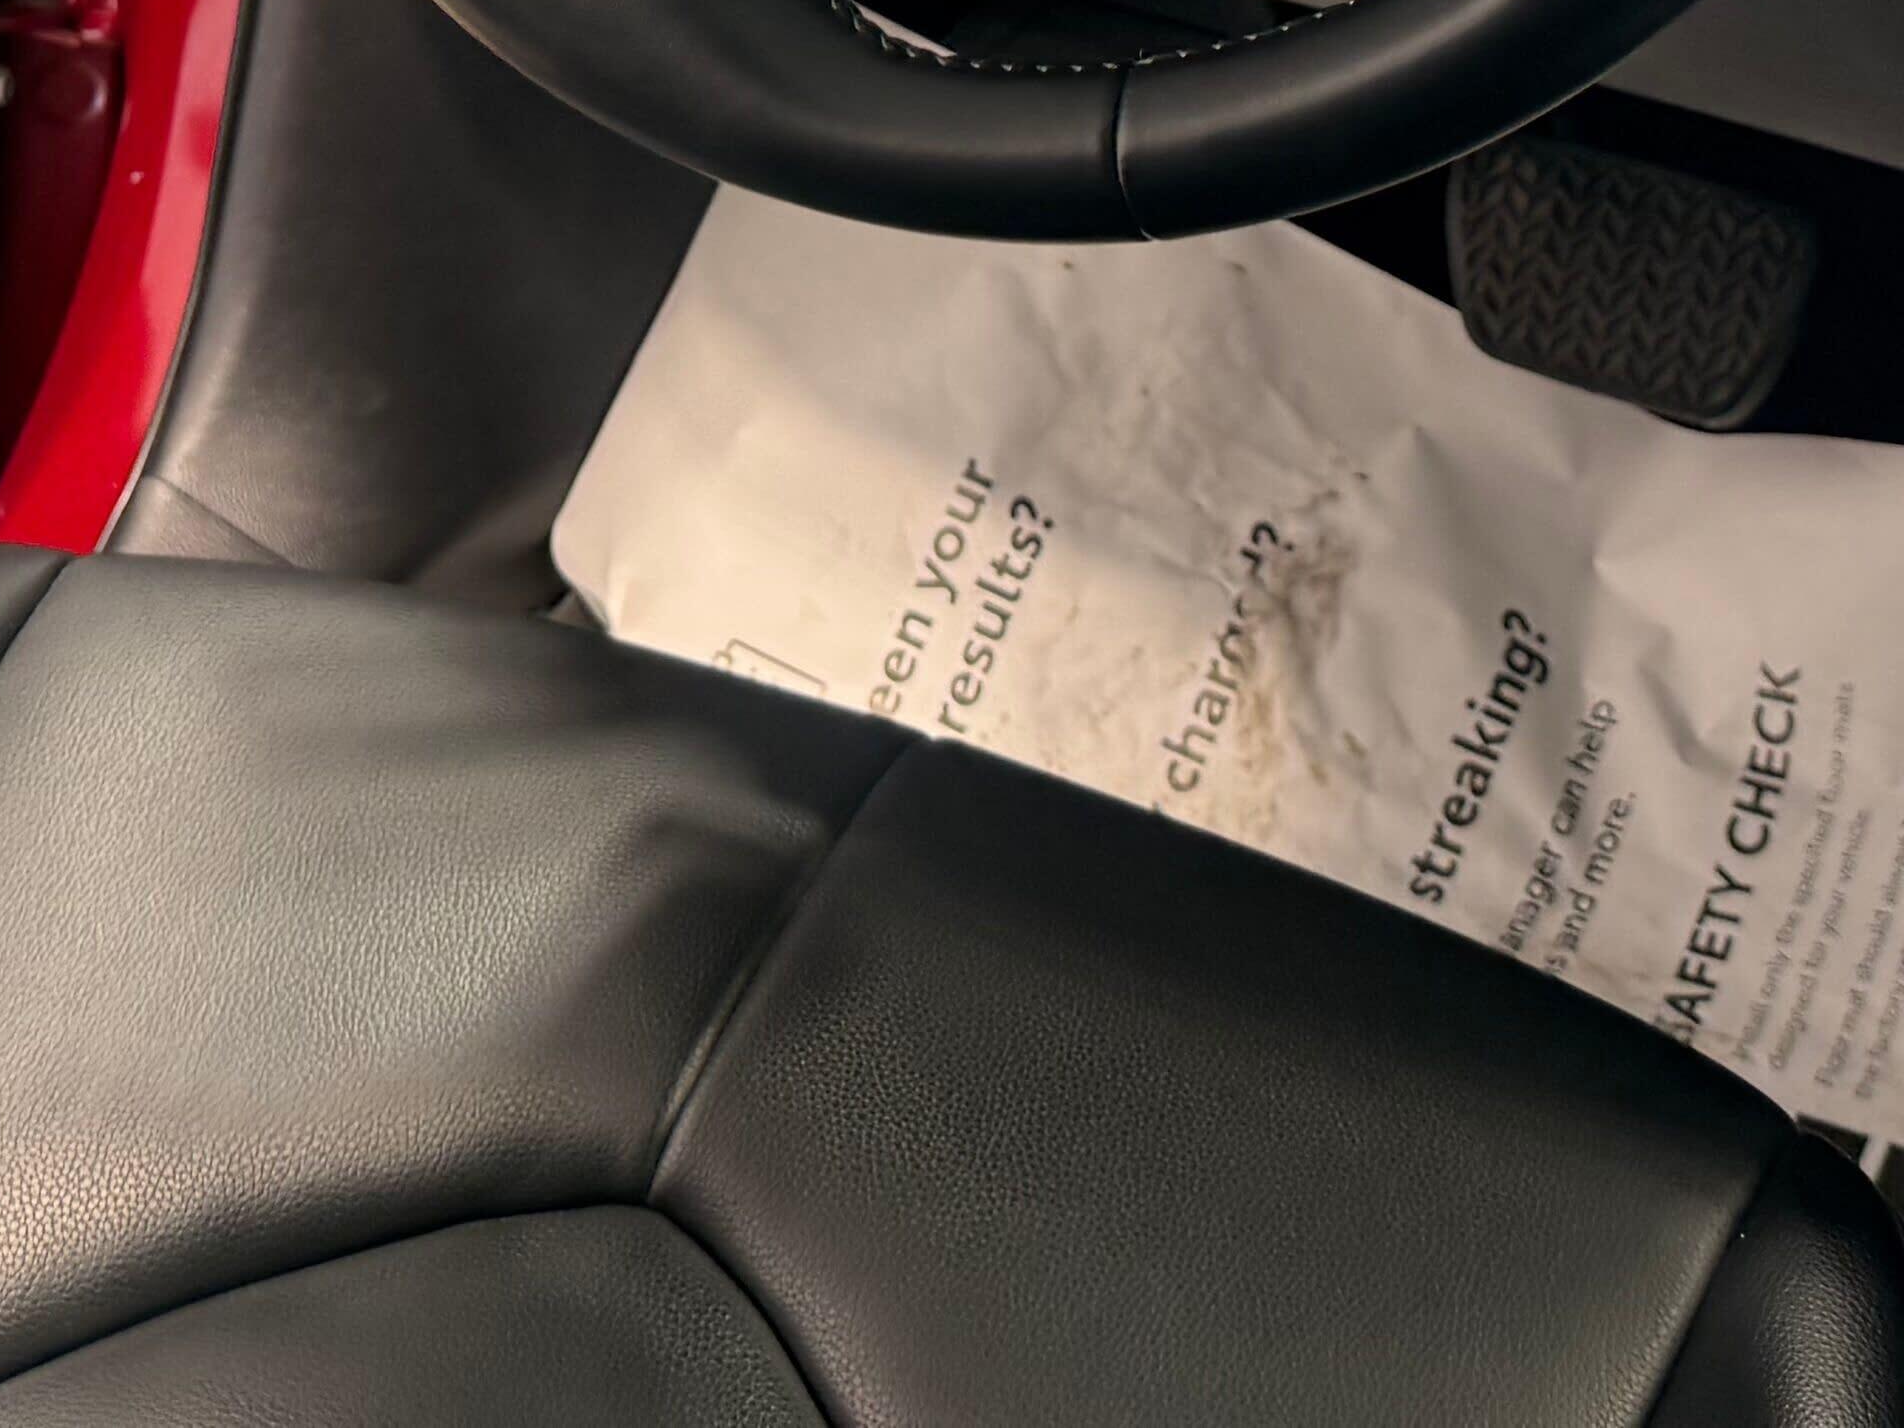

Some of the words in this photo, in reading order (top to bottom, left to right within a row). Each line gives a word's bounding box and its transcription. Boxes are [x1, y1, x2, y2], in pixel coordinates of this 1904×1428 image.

[912, 455, 996, 605] your
[935, 491, 1055, 736] results?
[1404, 606, 1549, 902] streaking?
[1549, 776, 1587, 838] can
[1562, 697, 1616, 774] help
[1720, 660, 1801, 857] CHECK
[1498, 839, 1565, 956] anager
[1551, 886, 1595, 952] and
[1583, 787, 1637, 886] more.
